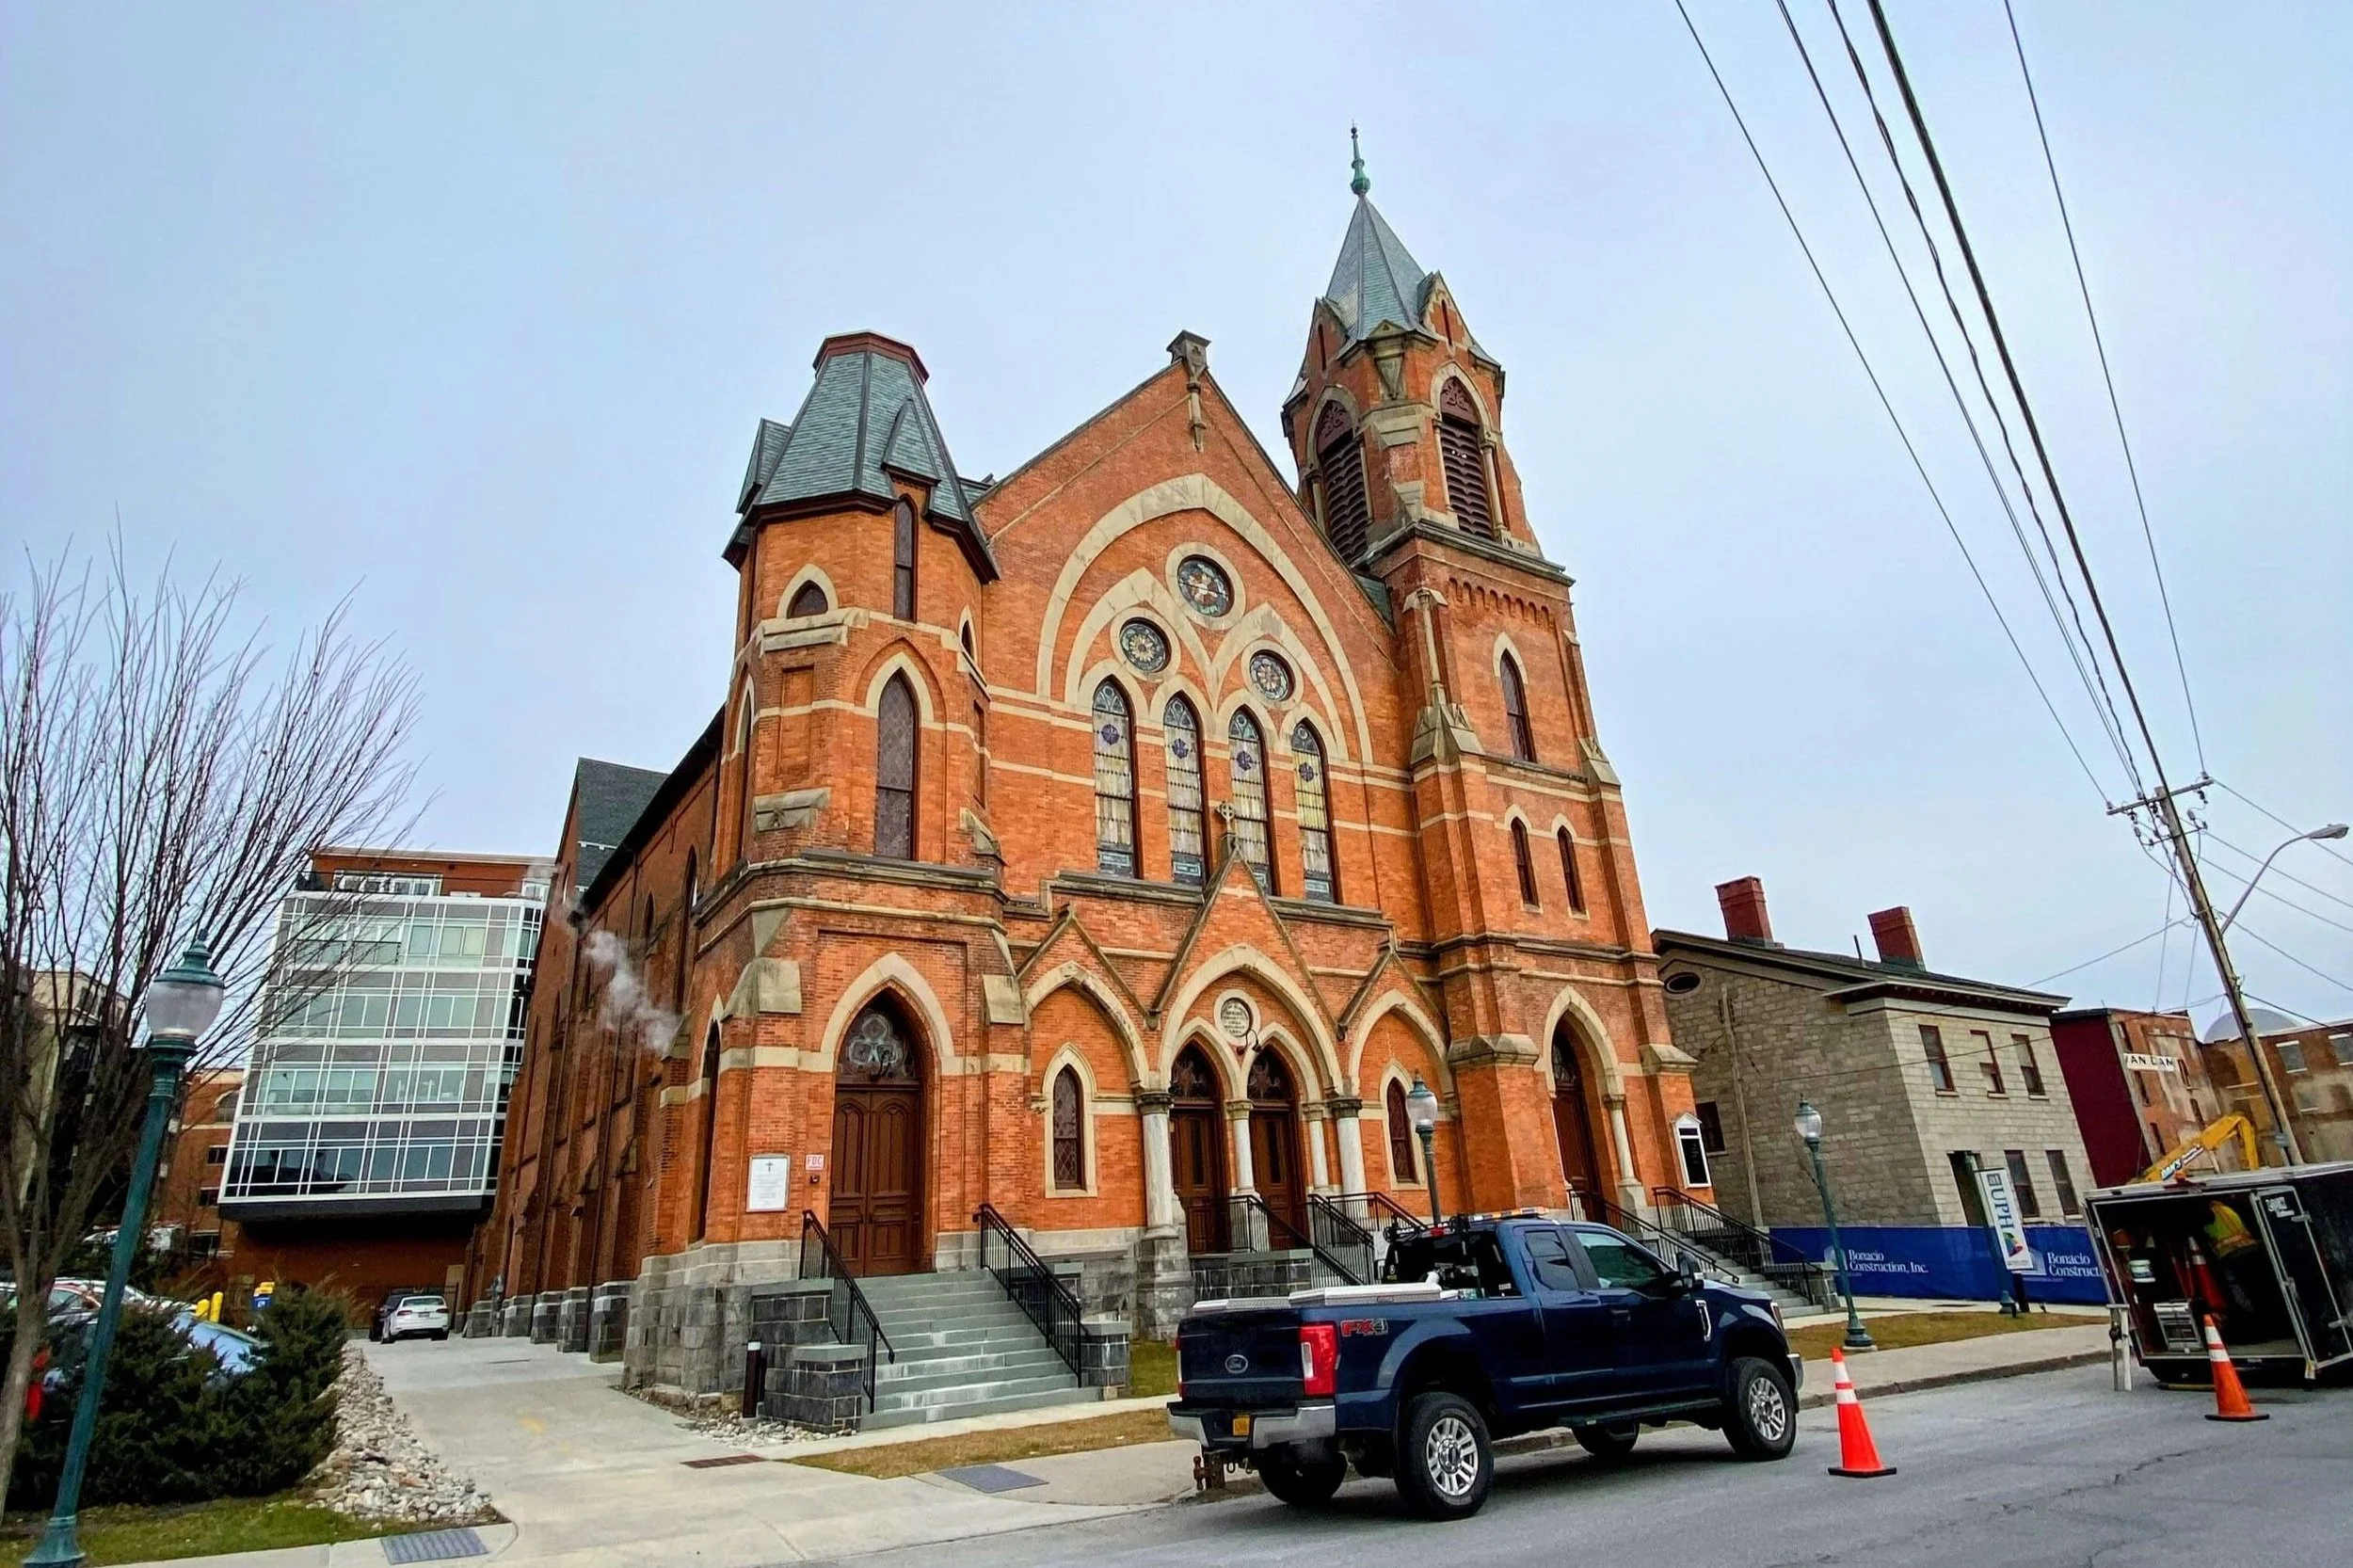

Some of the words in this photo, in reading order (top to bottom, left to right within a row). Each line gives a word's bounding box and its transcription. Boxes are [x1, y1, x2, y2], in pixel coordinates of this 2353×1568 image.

[808, 1156, 823, 1166] FDC
[1848, 1249, 1884, 1261] Bonacio
[2047, 1252, 2090, 1265] Bonacio
[1849, 1261, 1910, 1273] Construction,
[1910, 1261, 1929, 1273] Inc.
[2049, 1264, 2101, 1277] Construct
[1340, 1318, 1388, 1337] FX4
